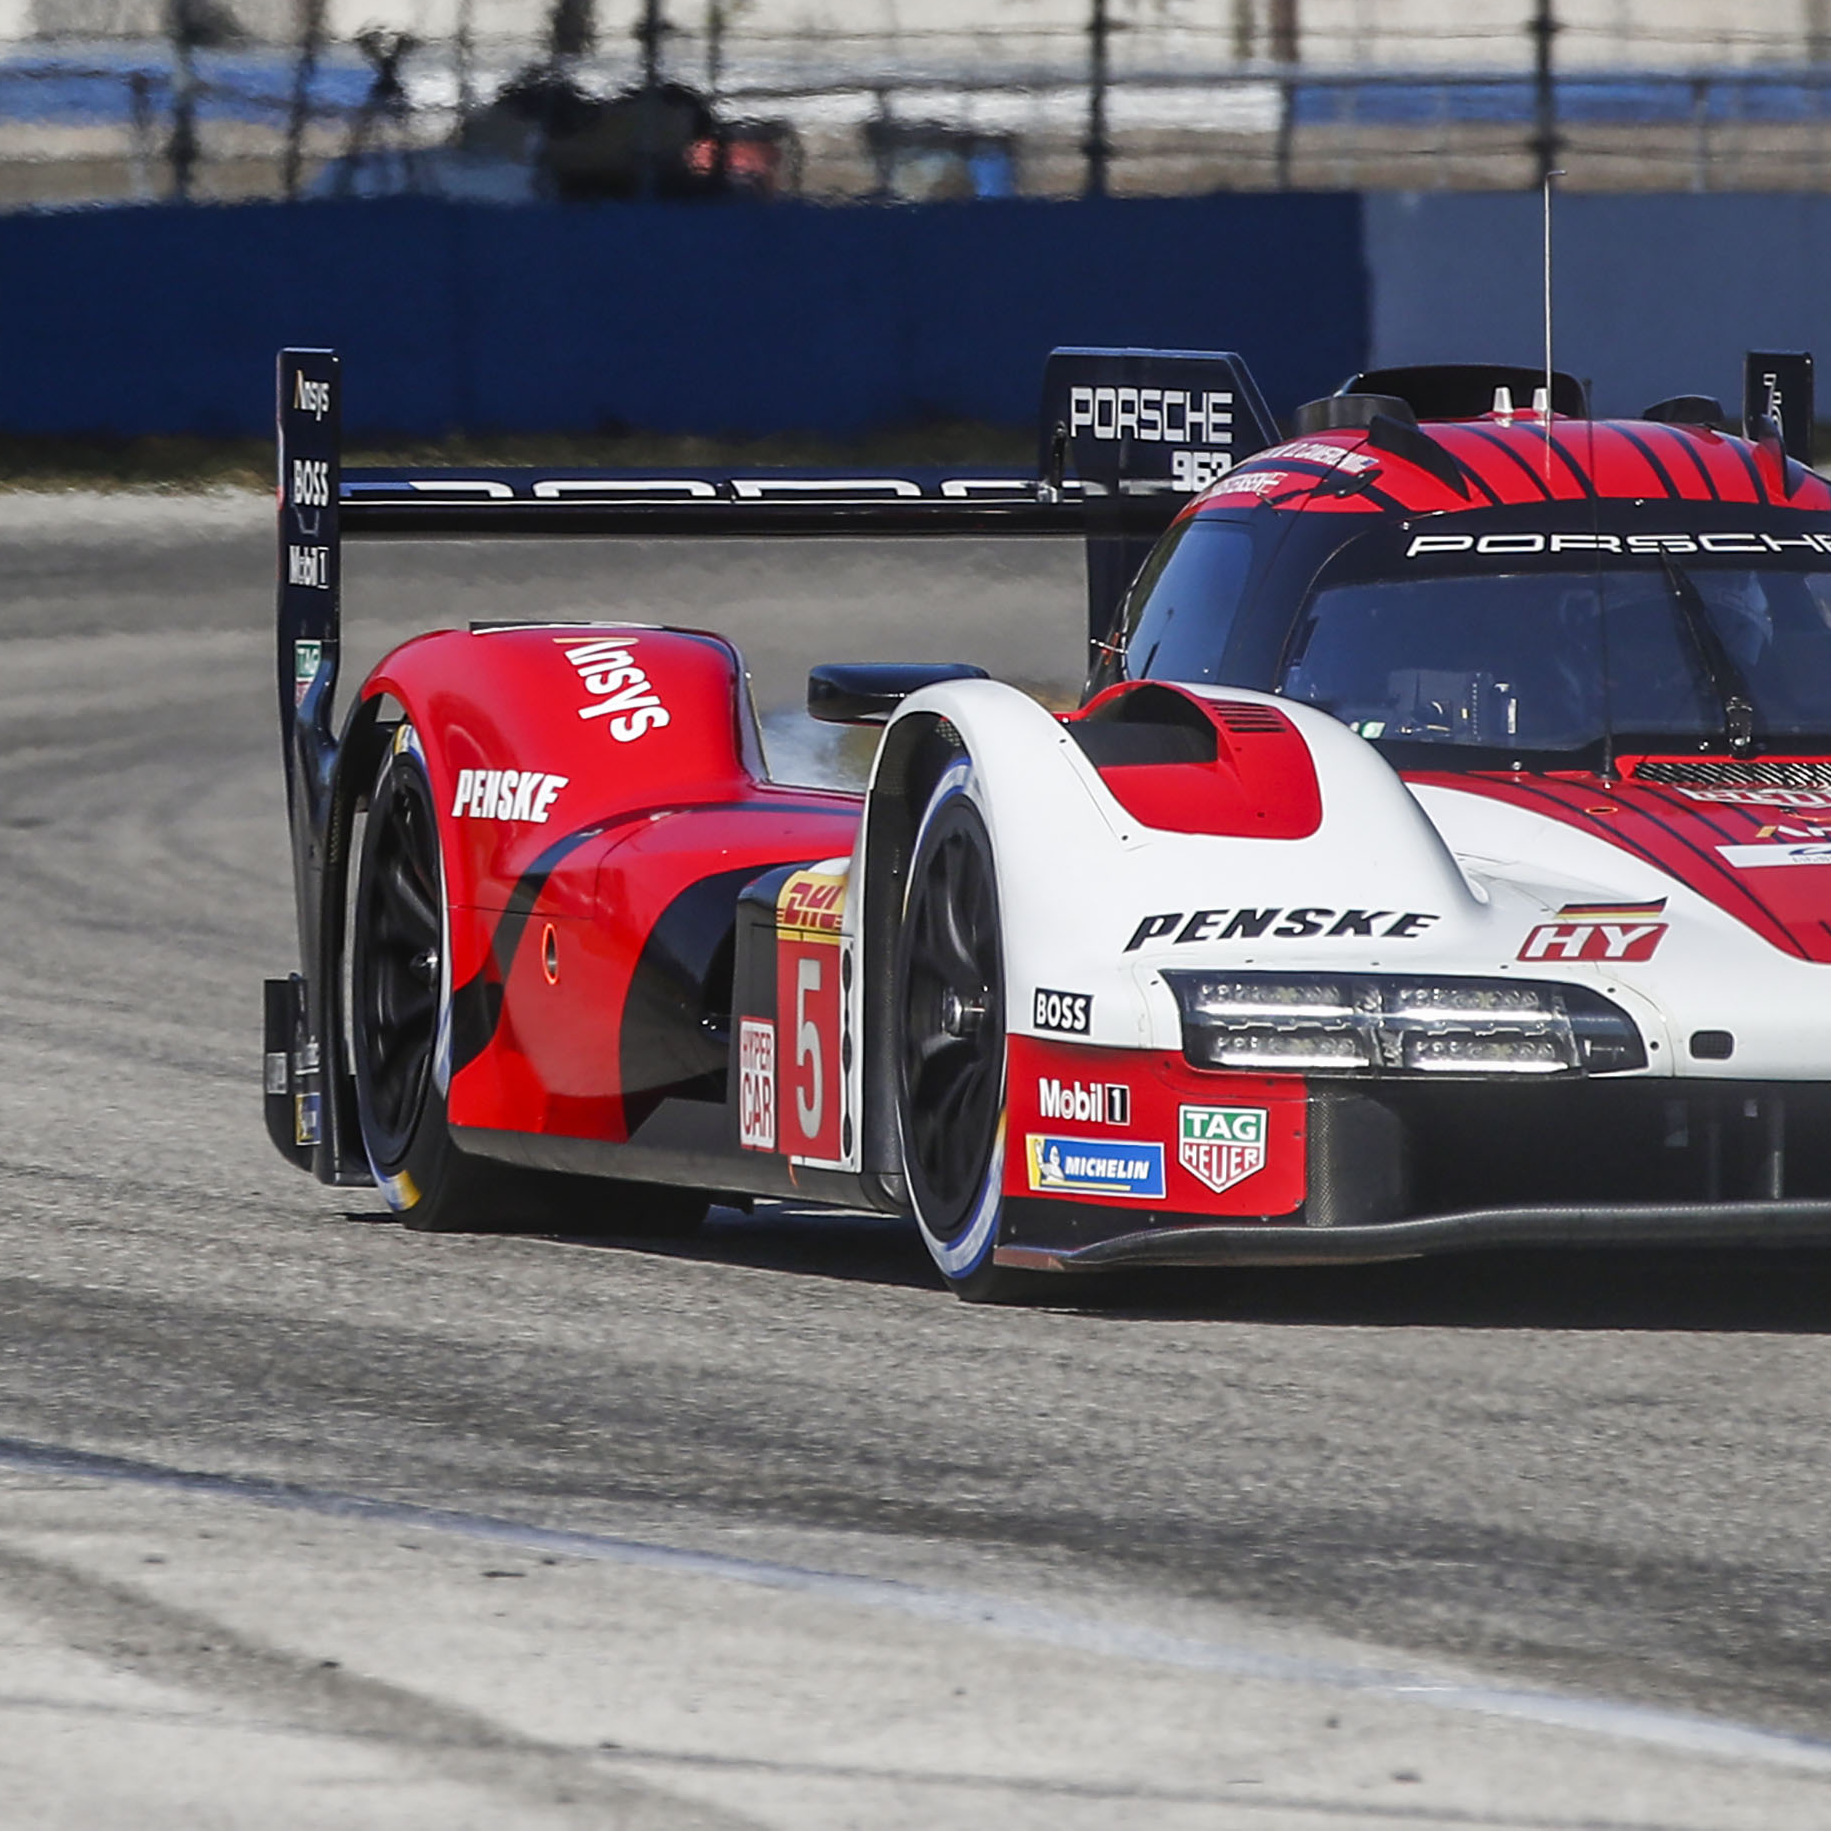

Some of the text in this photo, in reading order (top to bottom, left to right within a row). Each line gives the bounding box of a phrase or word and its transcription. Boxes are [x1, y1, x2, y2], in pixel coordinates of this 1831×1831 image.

[1070, 385, 1234, 445] PORSCHE
[292, 459, 329, 507] BOSS
[1171, 450, 1232, 493] 963
[289, 545, 319, 587] Mobil
[552, 636, 671, 743] Ansys
[451, 769, 570, 823] PENSKE
[783, 881, 844, 930] DHL
[1122, 907, 1442, 954] PENSKE
[1525, 924, 1657, 958] HY
[1036, 993, 1087, 1031] BOSS
[741, 1028, 774, 1070] HYPER
[796, 958, 823, 1139] 5
[743, 1071, 772, 1139] CAR
[1038, 1077, 1103, 1123] Mobil
[1185, 1112, 1258, 1142] TAG
[1063, 1155, 1151, 1181] MICHELIN
[1183, 1142, 1260, 1187] HEUER
